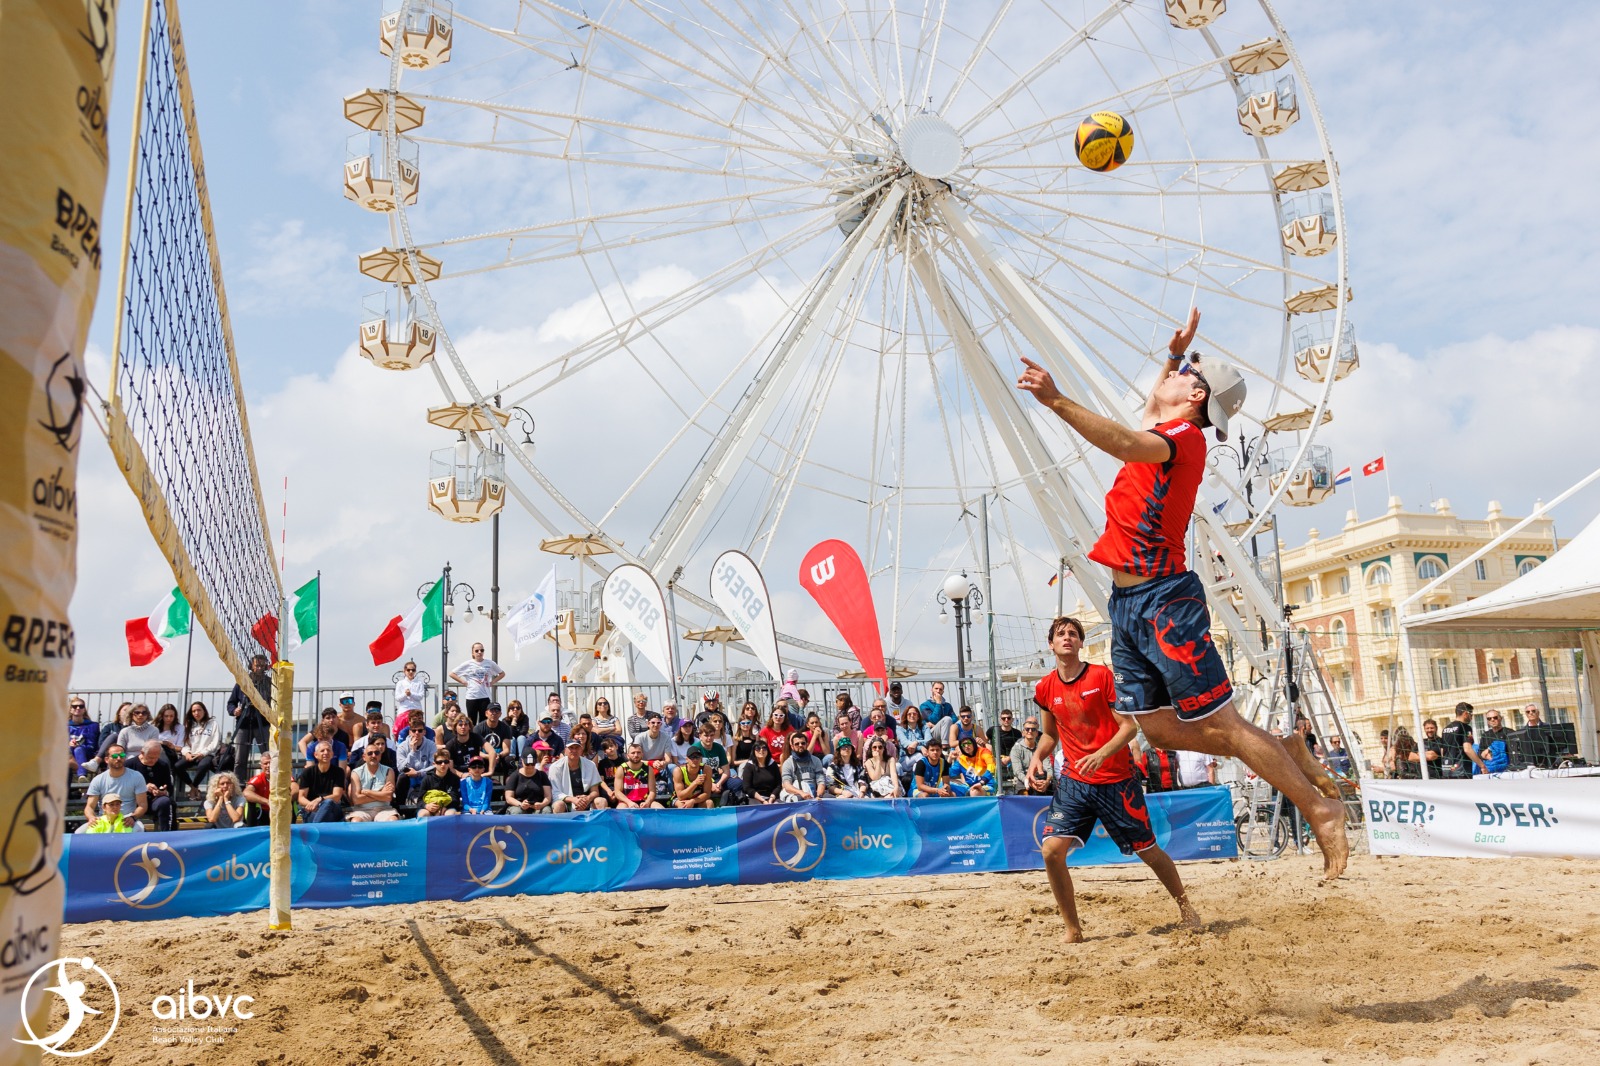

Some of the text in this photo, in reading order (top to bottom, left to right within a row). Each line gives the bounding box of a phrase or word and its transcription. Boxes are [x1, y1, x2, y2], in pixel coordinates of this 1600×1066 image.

[439, 23, 446, 34] 16
[406, 168, 412, 178] 17
[422, 329, 429, 339] 18
[438, 481, 446, 491] 19
[491, 483, 498, 494] 19
[33, 466, 77, 518] aibv
[1178, 679, 1232, 712] iBeac
[842, 826, 893, 851] aibvc
[946, 832, 990, 841] www.aibvc.it
[1373, 829, 1400, 840] Banca
[1474, 832, 1506, 844] Banca
[546, 838, 608, 865] aibvc
[672, 846, 722, 854] www.aibvc.it
[352, 859, 408, 868] www.aibvc.it
